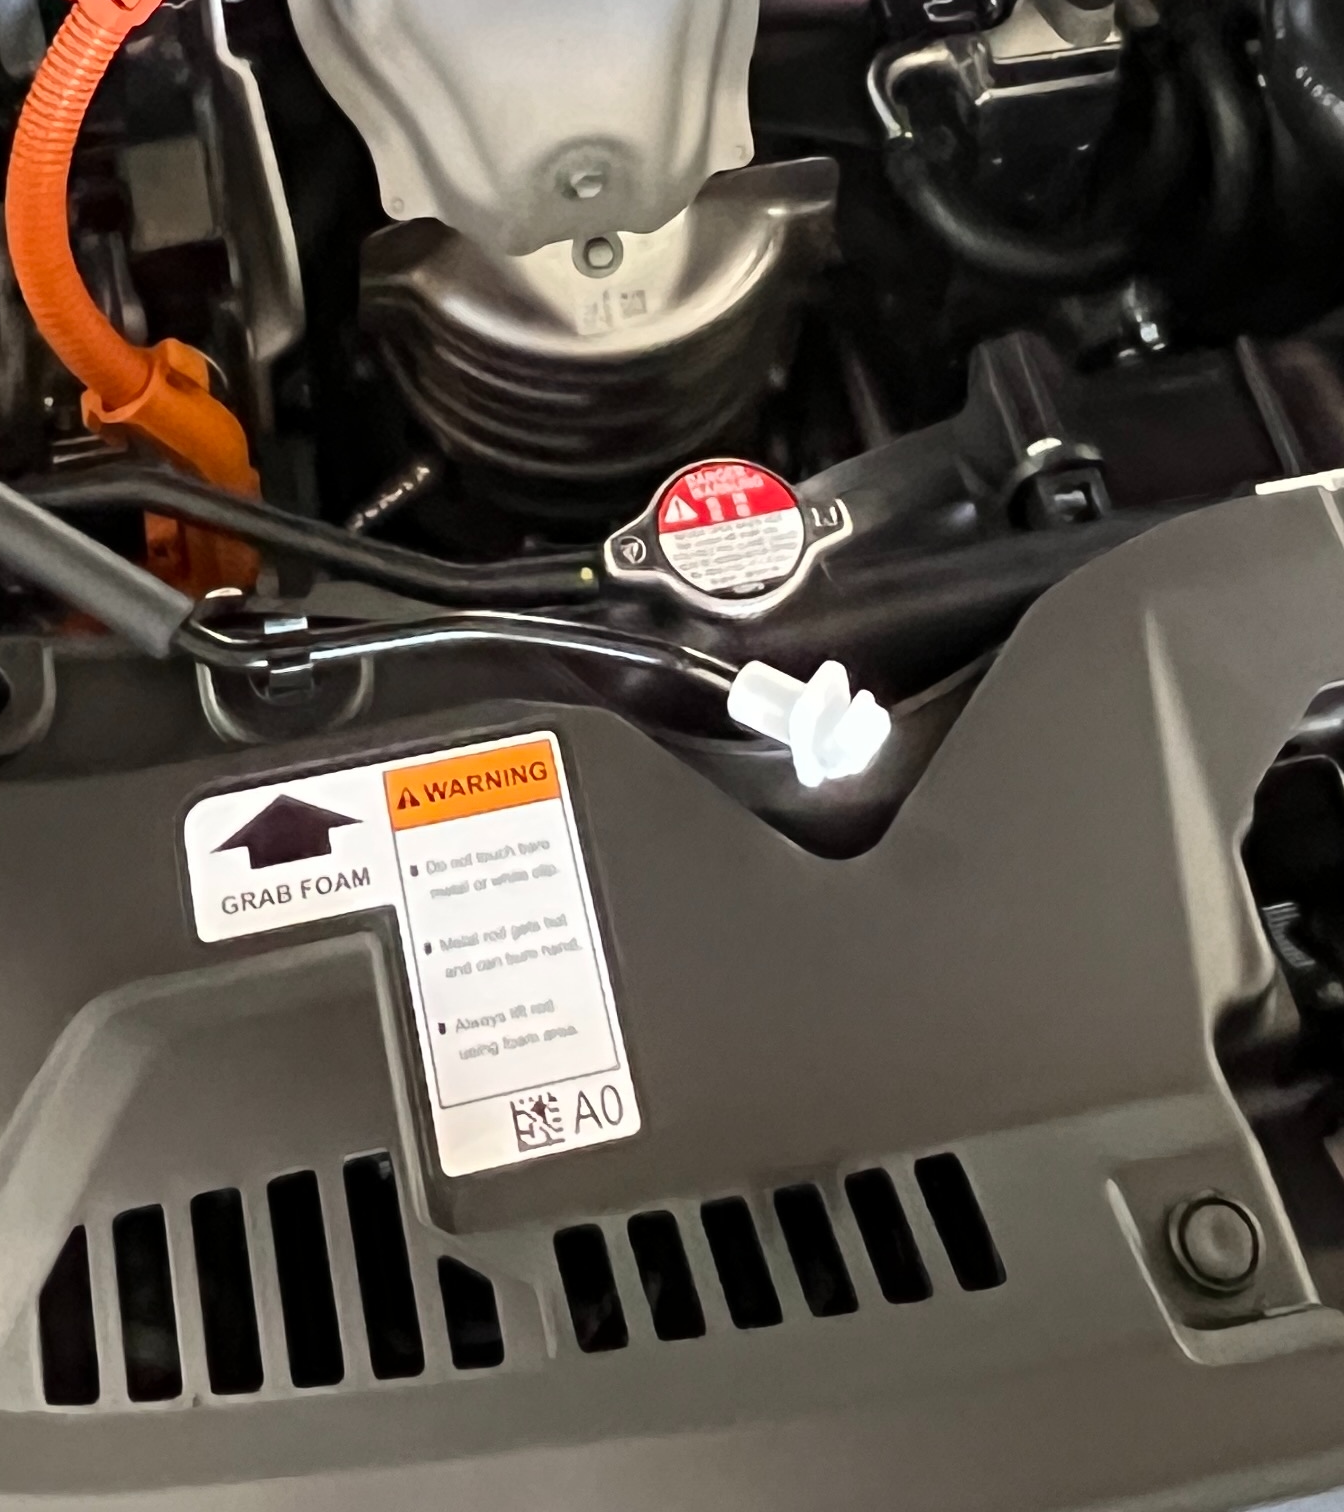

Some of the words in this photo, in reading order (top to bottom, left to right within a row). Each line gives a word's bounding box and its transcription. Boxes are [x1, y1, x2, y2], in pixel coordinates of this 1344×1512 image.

[423, 761, 548, 803] WARNING
[221, 884, 292, 915] GRAB
[300, 867, 371, 899] FOAM
